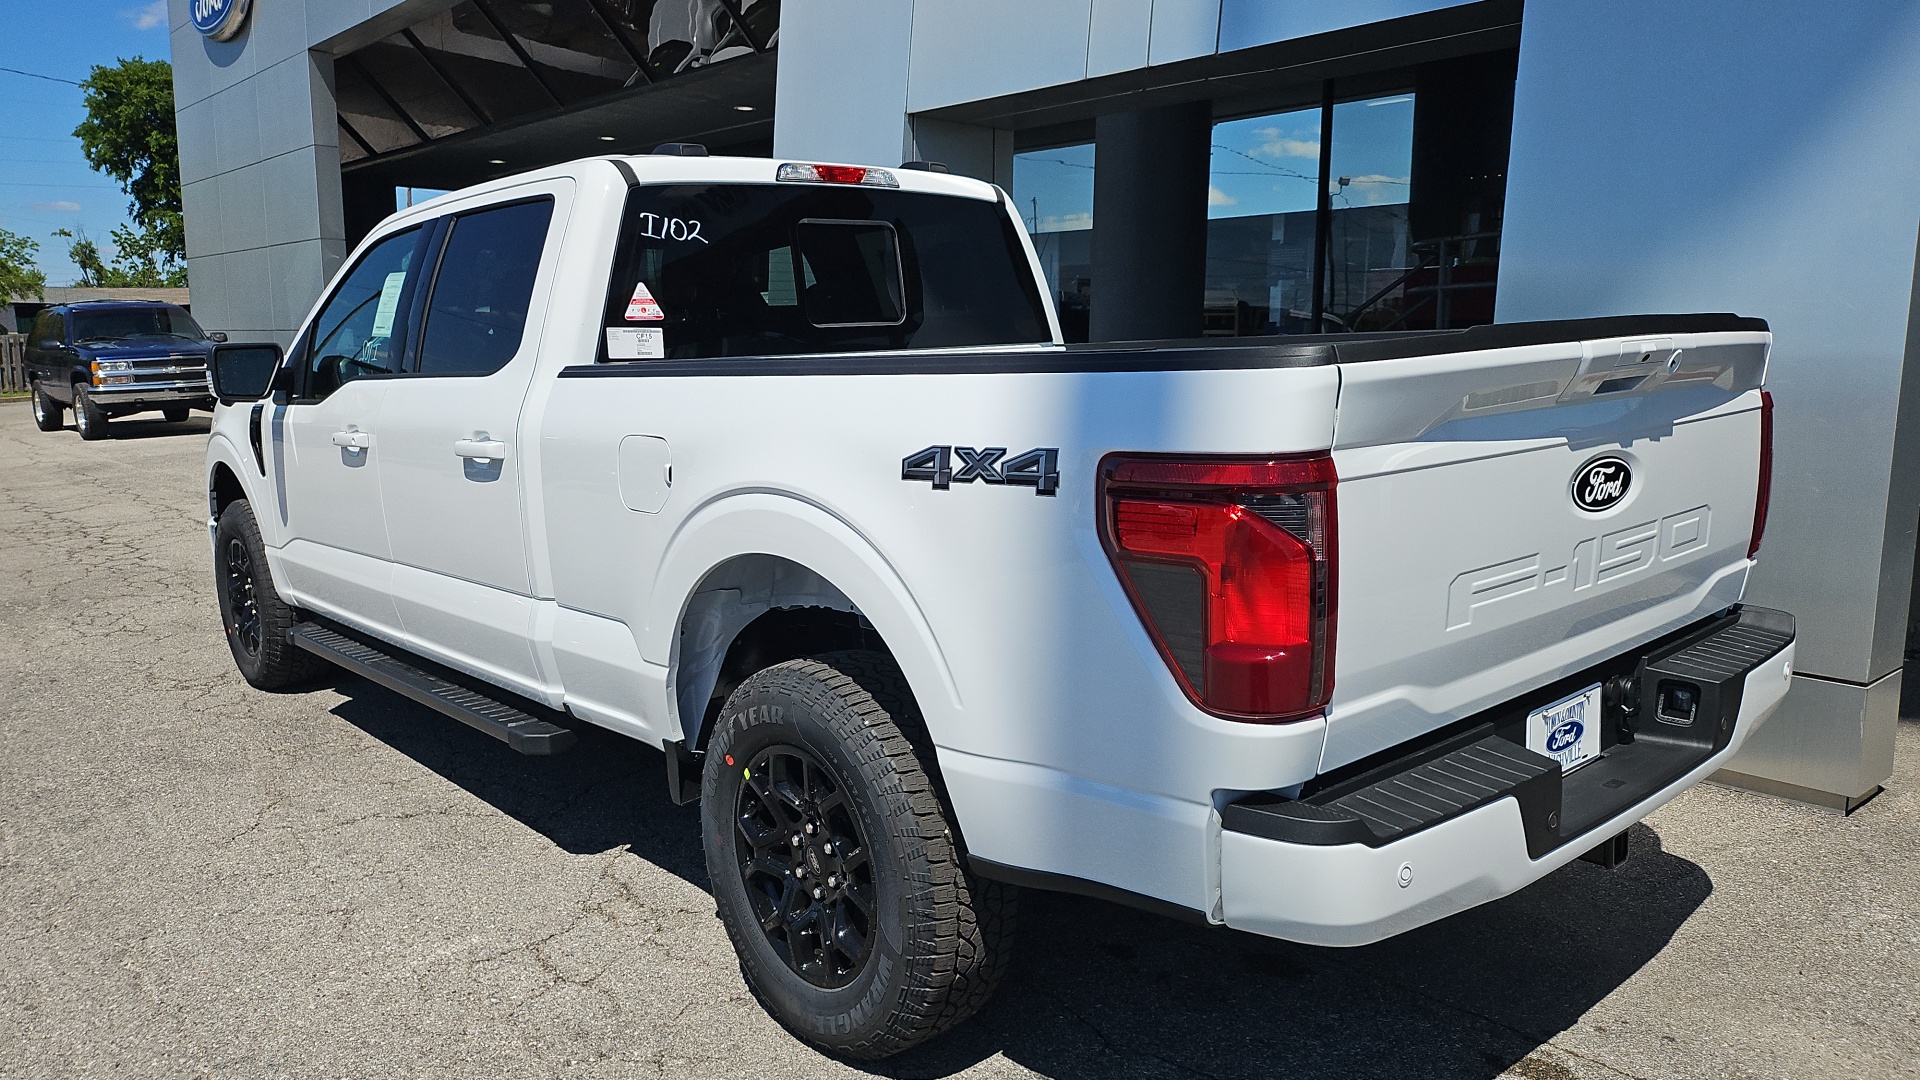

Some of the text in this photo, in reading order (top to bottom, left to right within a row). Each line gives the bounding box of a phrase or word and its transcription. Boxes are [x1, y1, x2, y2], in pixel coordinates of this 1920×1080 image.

[639, 212, 709, 244] I102
[1584, 465, 1625, 503] Ford
[1445, 503, 1713, 632] F-150
[1551, 724, 1577, 750] Ford
[814, 952, 894, 1036] WRANGLE
